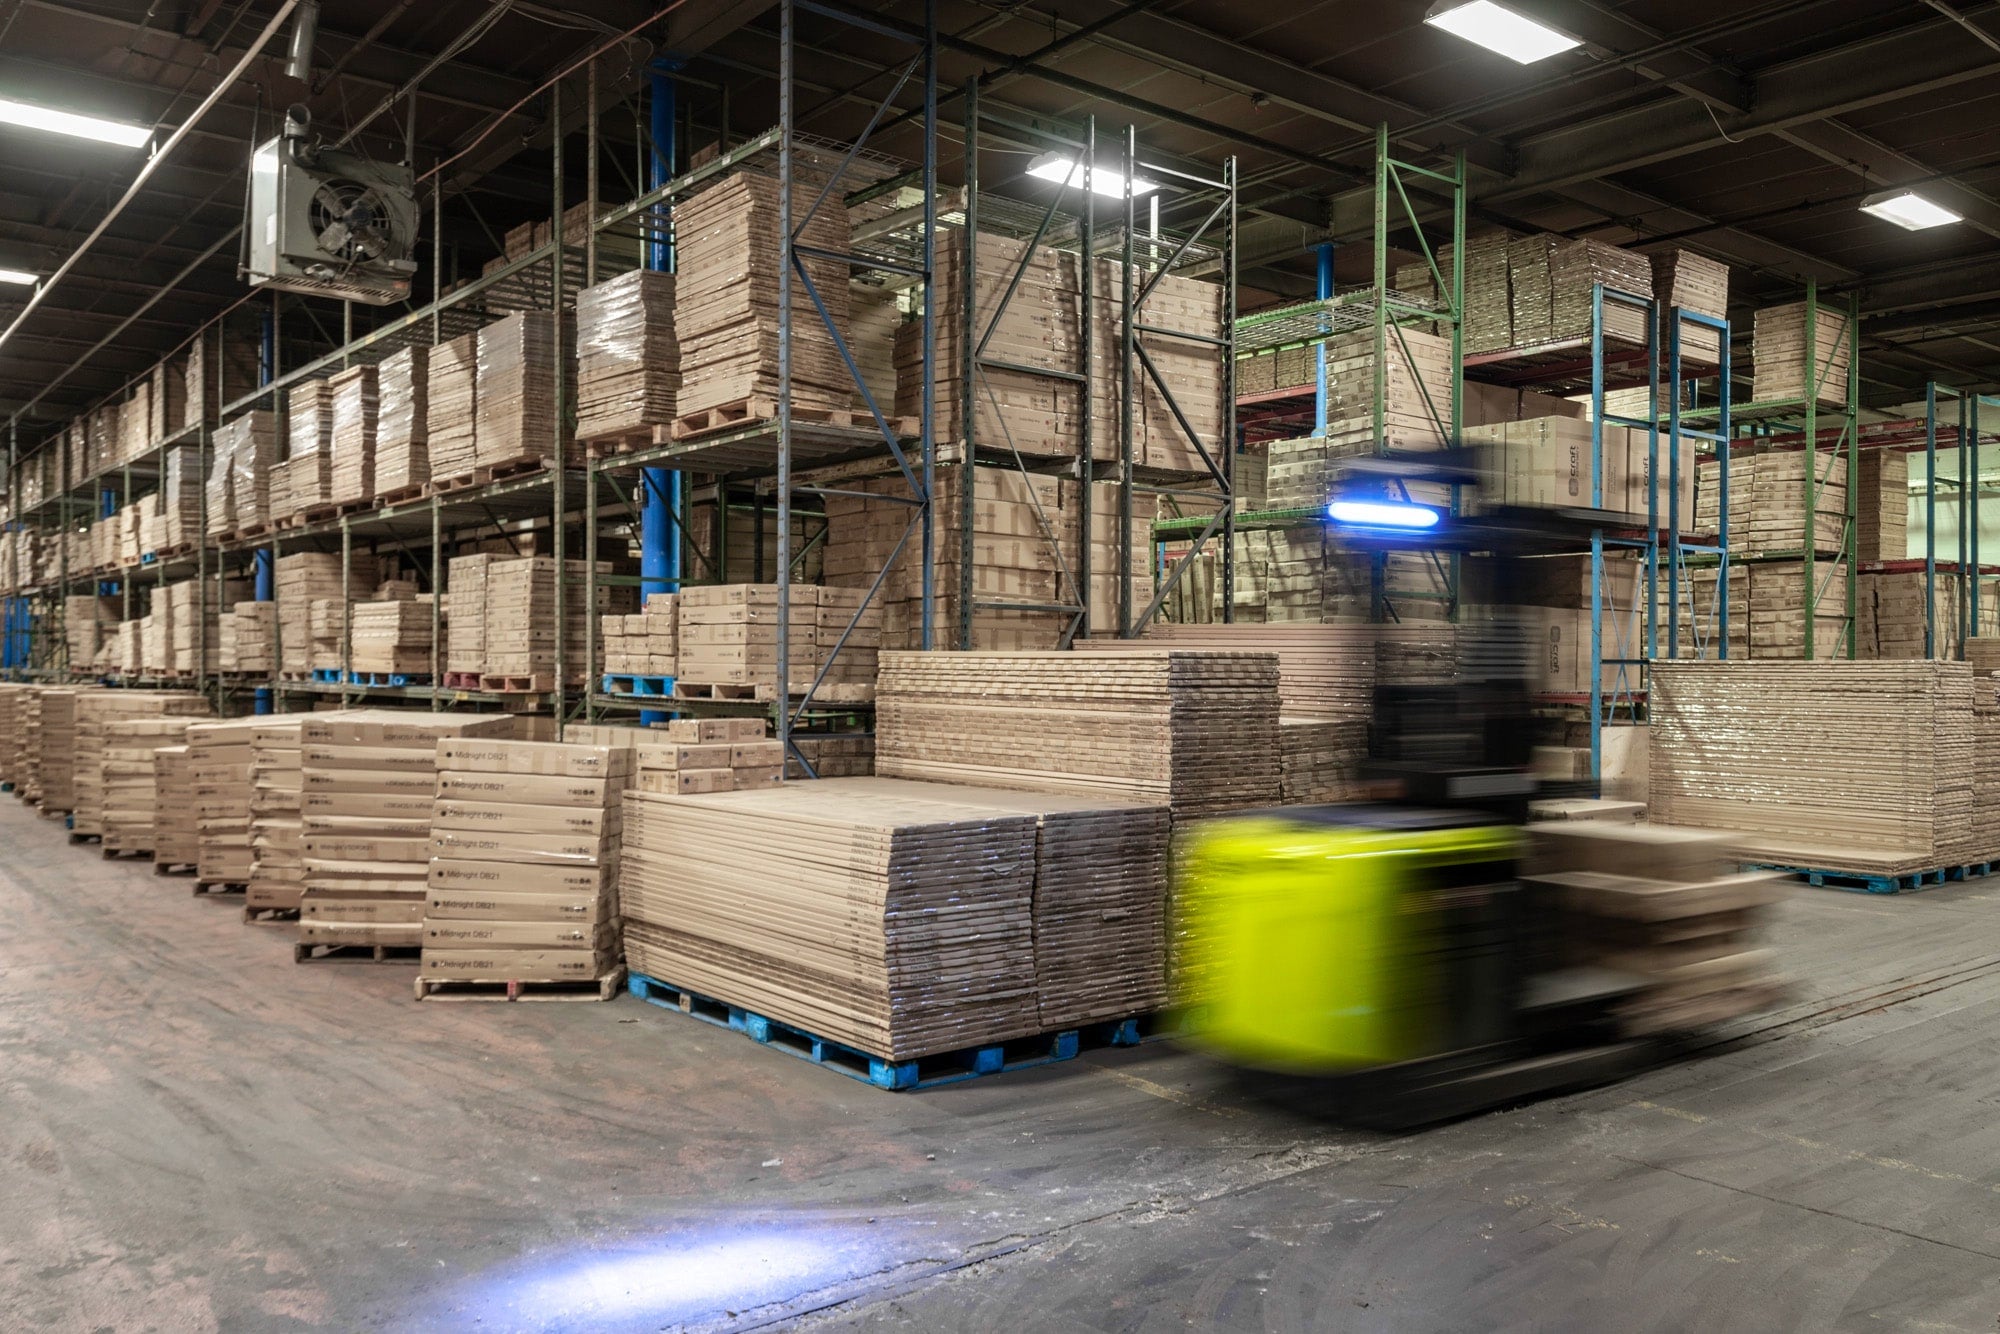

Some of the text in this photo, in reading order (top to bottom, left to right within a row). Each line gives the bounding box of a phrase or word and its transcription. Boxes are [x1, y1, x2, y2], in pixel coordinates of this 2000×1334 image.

[1552, 644, 1560, 674] craft
[455, 751, 508, 762] Midnight DB21
[451, 781, 504, 791] Midnight DB21
[482, 811, 503, 820] DB21
[446, 838, 477, 849] Midnight
[447, 870, 500, 880] Midnight DB21
[442, 900, 473, 910] Midnight
[440, 929, 471, 939] Midnight
